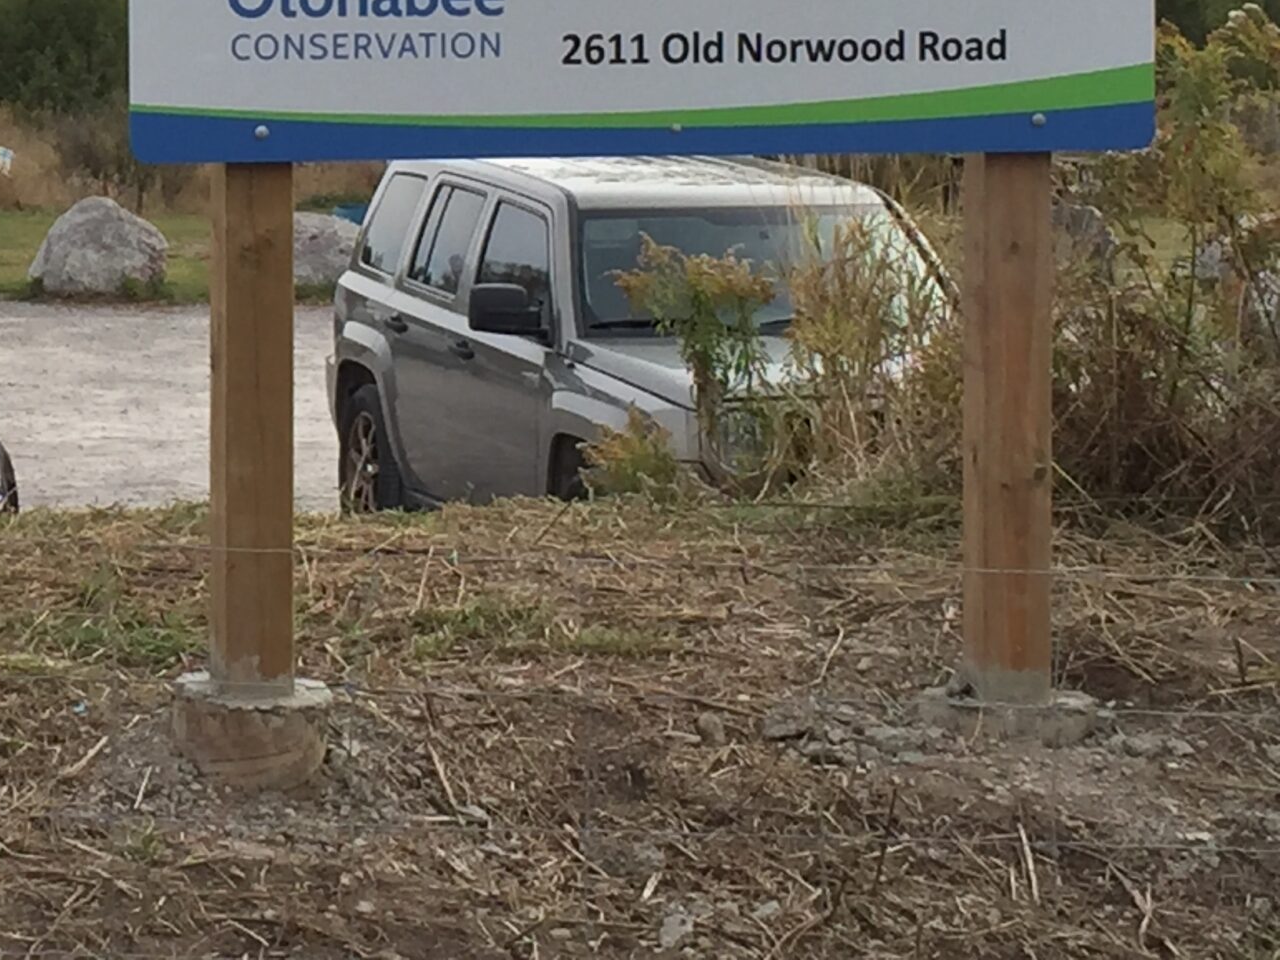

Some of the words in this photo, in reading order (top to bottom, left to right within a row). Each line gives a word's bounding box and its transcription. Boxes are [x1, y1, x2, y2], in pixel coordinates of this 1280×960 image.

[231, 32, 501, 61] CONSERVATION
[561, 32, 651, 66] 2611
[661, 30, 724, 65] Old
[737, 28, 905, 64] Norwood
[918, 28, 1007, 62] Road
